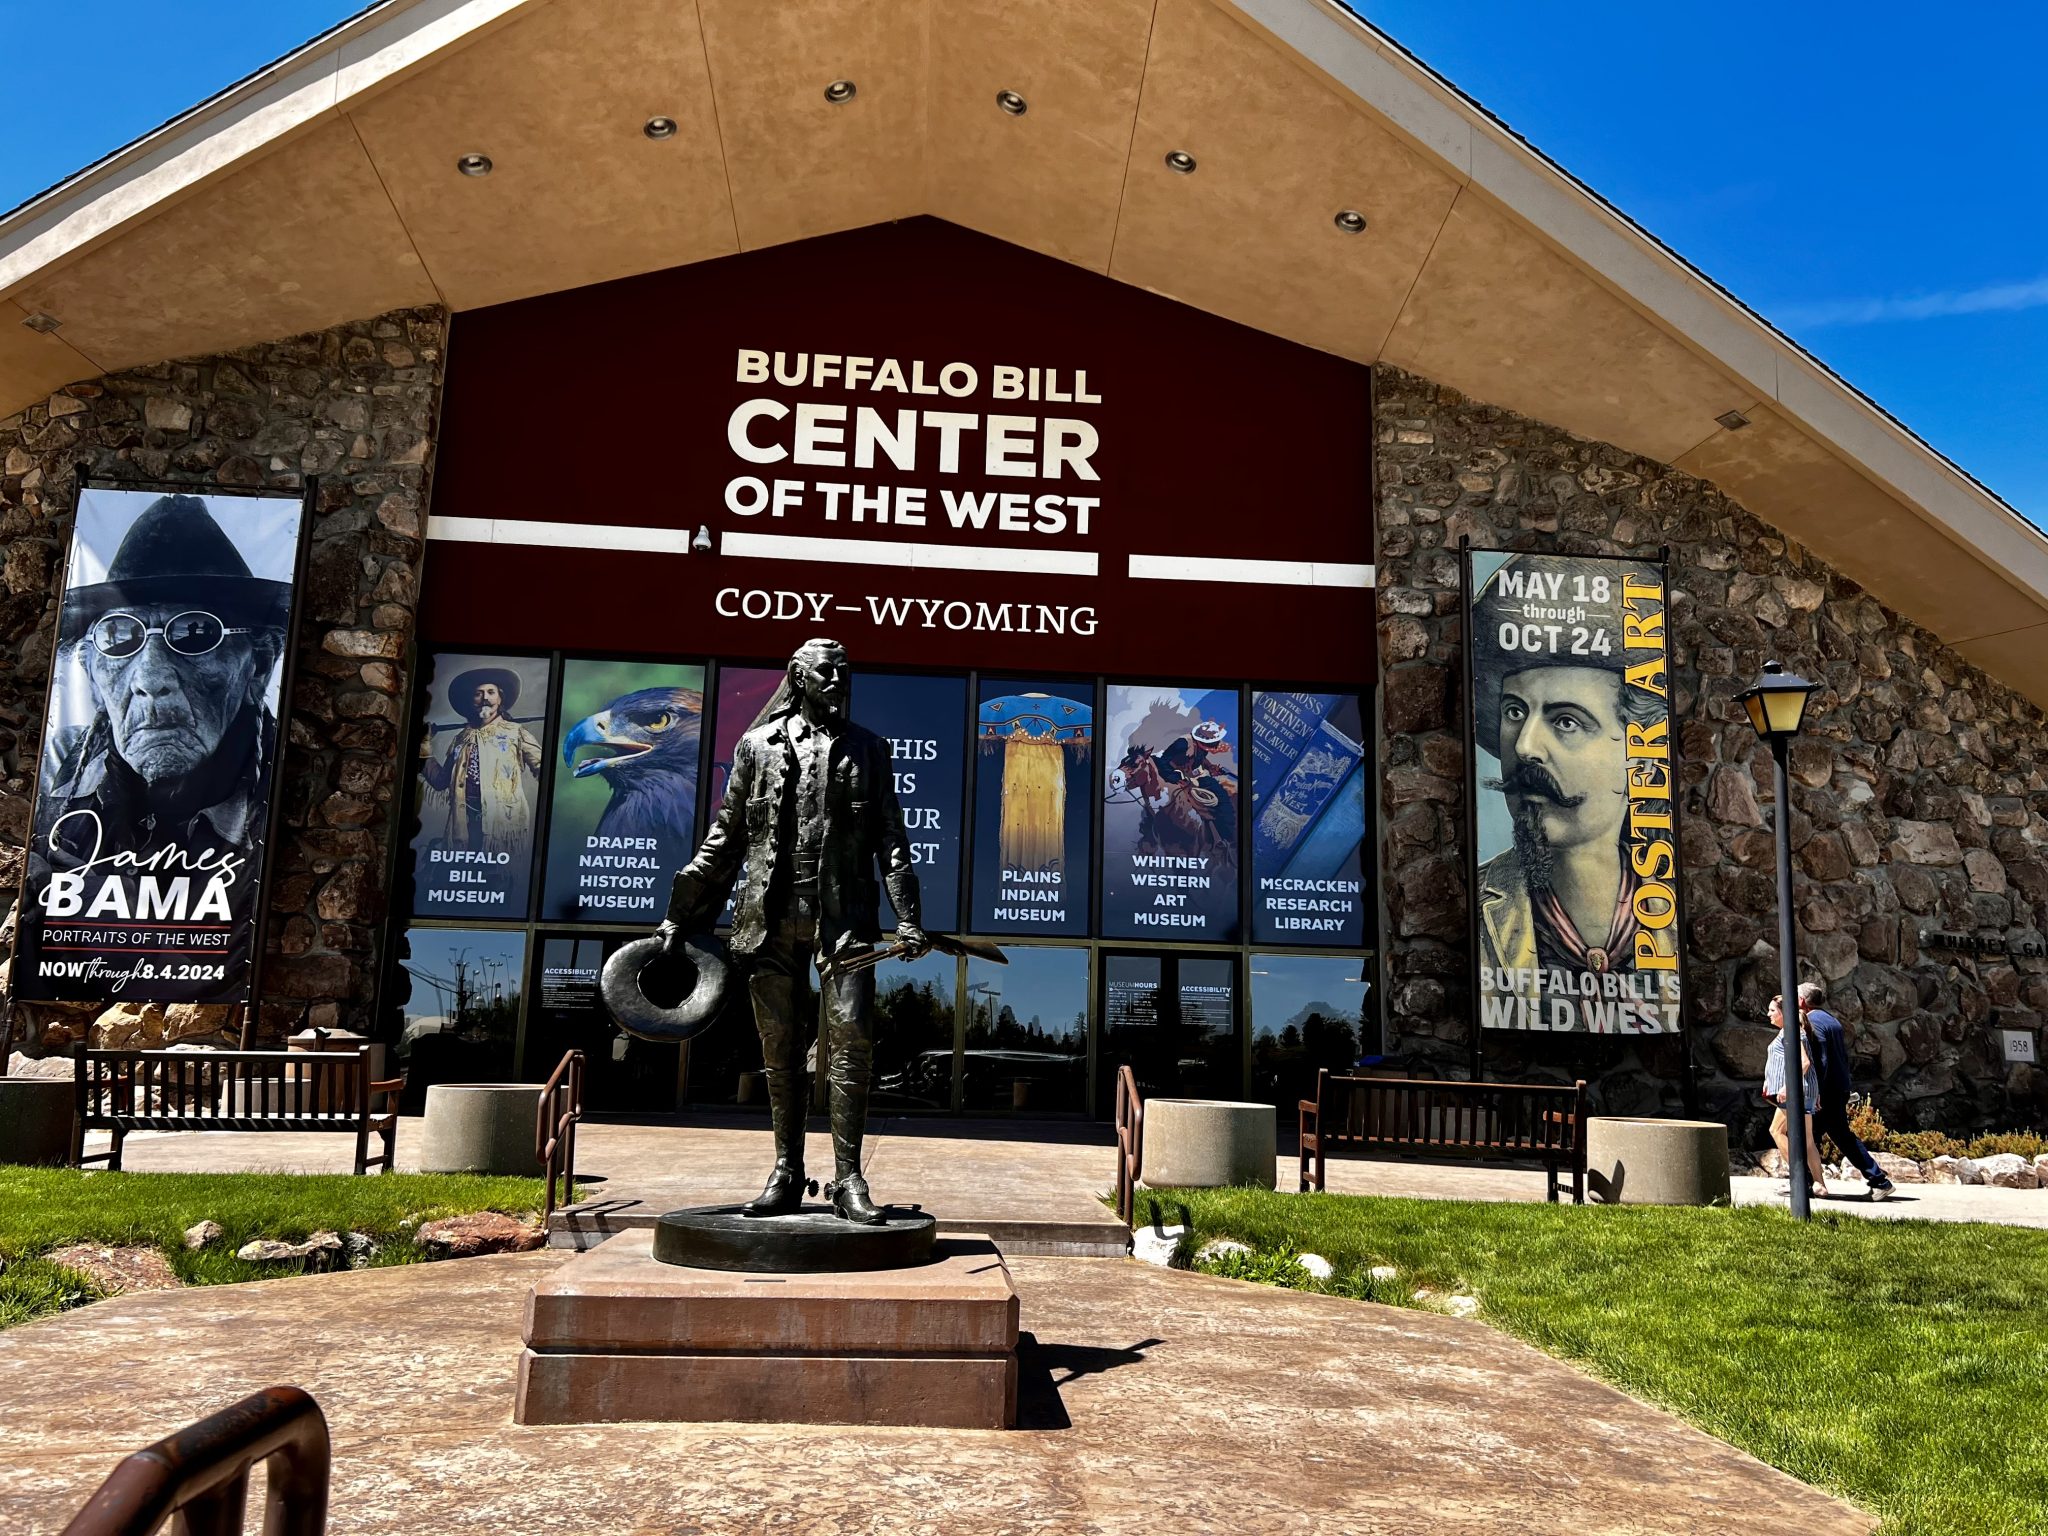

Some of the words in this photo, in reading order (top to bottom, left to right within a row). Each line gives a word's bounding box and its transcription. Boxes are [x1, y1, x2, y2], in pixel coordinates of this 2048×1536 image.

[736, 348, 979, 398] BUFFALO
[992, 364, 1102, 404] BILL
[727, 398, 1101, 481] CENTER
[724, 476, 805, 518] OF
[815, 481, 927, 527] THE
[939, 489, 1100, 535] WEST
[1498, 569, 1566, 601] MAY
[1572, 574, 1611, 604] 18
[1522, 603, 1586, 624] through
[1499, 622, 1563, 653] OCT
[1571, 626, 1612, 657] 24
[1621, 572, 1669, 700] ART
[882, 737, 938, 761] HIS
[902, 807, 941, 830] UR
[586, 835, 658, 850] DRAPER
[1625, 715, 1679, 974] POSTER
[38, 809, 246, 907] James
[430, 850, 510, 865] BUFFALO
[579, 854, 661, 870] NATURAL
[1132, 855, 1209, 870] WHITNEY
[449, 870, 487, 884] BILL
[580, 875, 656, 889] HISTORY
[1002, 870, 1062, 884] PLAINS
[1131, 873, 1210, 889] WESTERN
[45, 872, 233, 921] BAMA
[428, 889, 505, 904] MUSEUM
[578, 894, 655, 909] MUSEUM
[1001, 889, 1059, 903] INDIAN
[1153, 894, 1187, 907] ART
[1266, 897, 1352, 913] RESEARCH
[994, 908, 1066, 922] MUSEUM
[1134, 912, 1206, 928] MUSEUM
[1274, 917, 1345, 931] LIBRARY
[42, 929, 127, 944] PORTRAITS
[131, 932, 151, 945] OF
[156, 932, 185, 945] THE
[189, 933, 231, 946] WEST
[38, 961, 84, 978] NOW
[142, 964, 225, 980] 8.4.2024
[544, 967, 599, 976] ACCESSIBILITY
[1180, 985, 1232, 993] ACCESSIBILITY
[1480, 966, 1598, 997] BUFFALO
[1602, 972, 1681, 1000] BILL'S
[1480, 995, 1576, 1032] WILD
[1585, 1001, 1682, 1034] WEST
